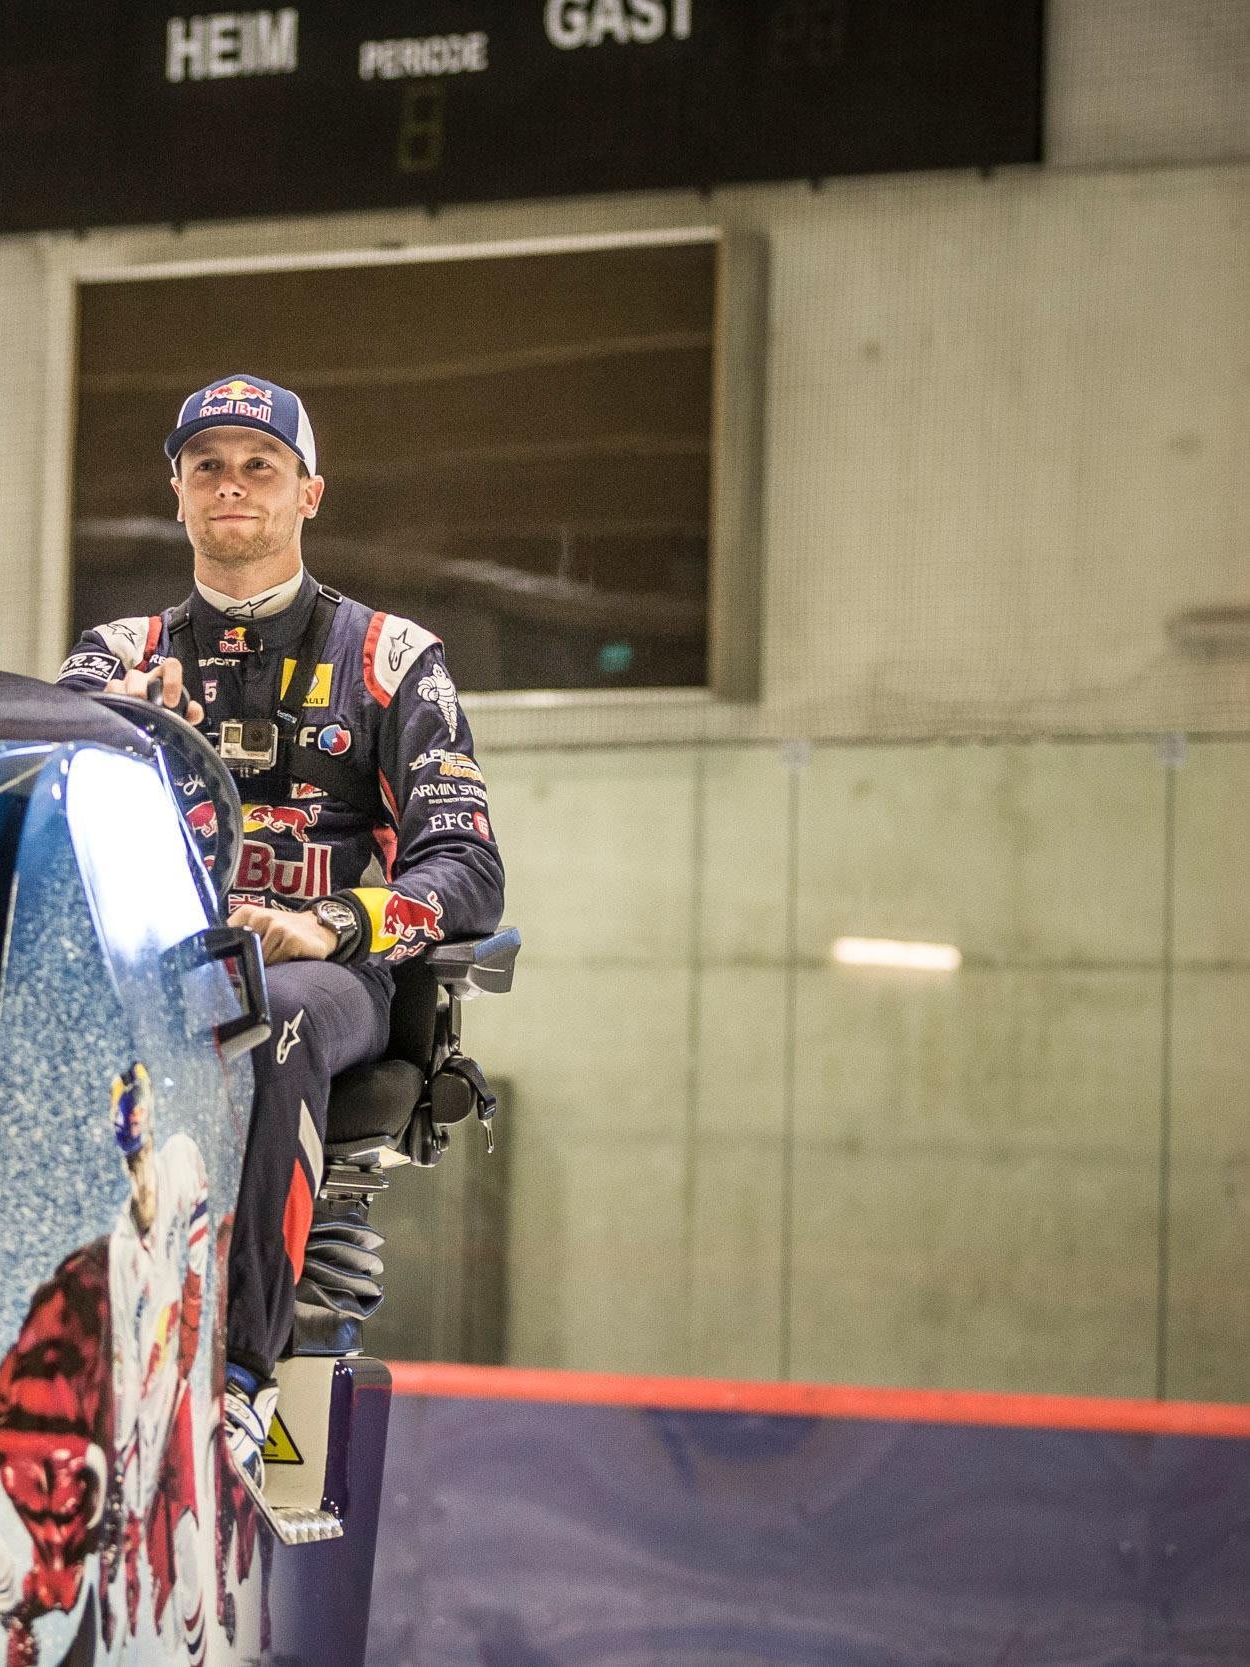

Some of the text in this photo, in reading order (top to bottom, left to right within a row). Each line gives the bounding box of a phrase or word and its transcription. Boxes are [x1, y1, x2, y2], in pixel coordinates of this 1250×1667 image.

[165, 7, 298, 82] HEIM
[235, 400, 272, 423] Bull
[198, 657, 241, 667] SPORT
[410, 783, 457, 800] ARMIN
[429, 811, 474, 833] EFG
[233, 839, 333, 899] Bull
